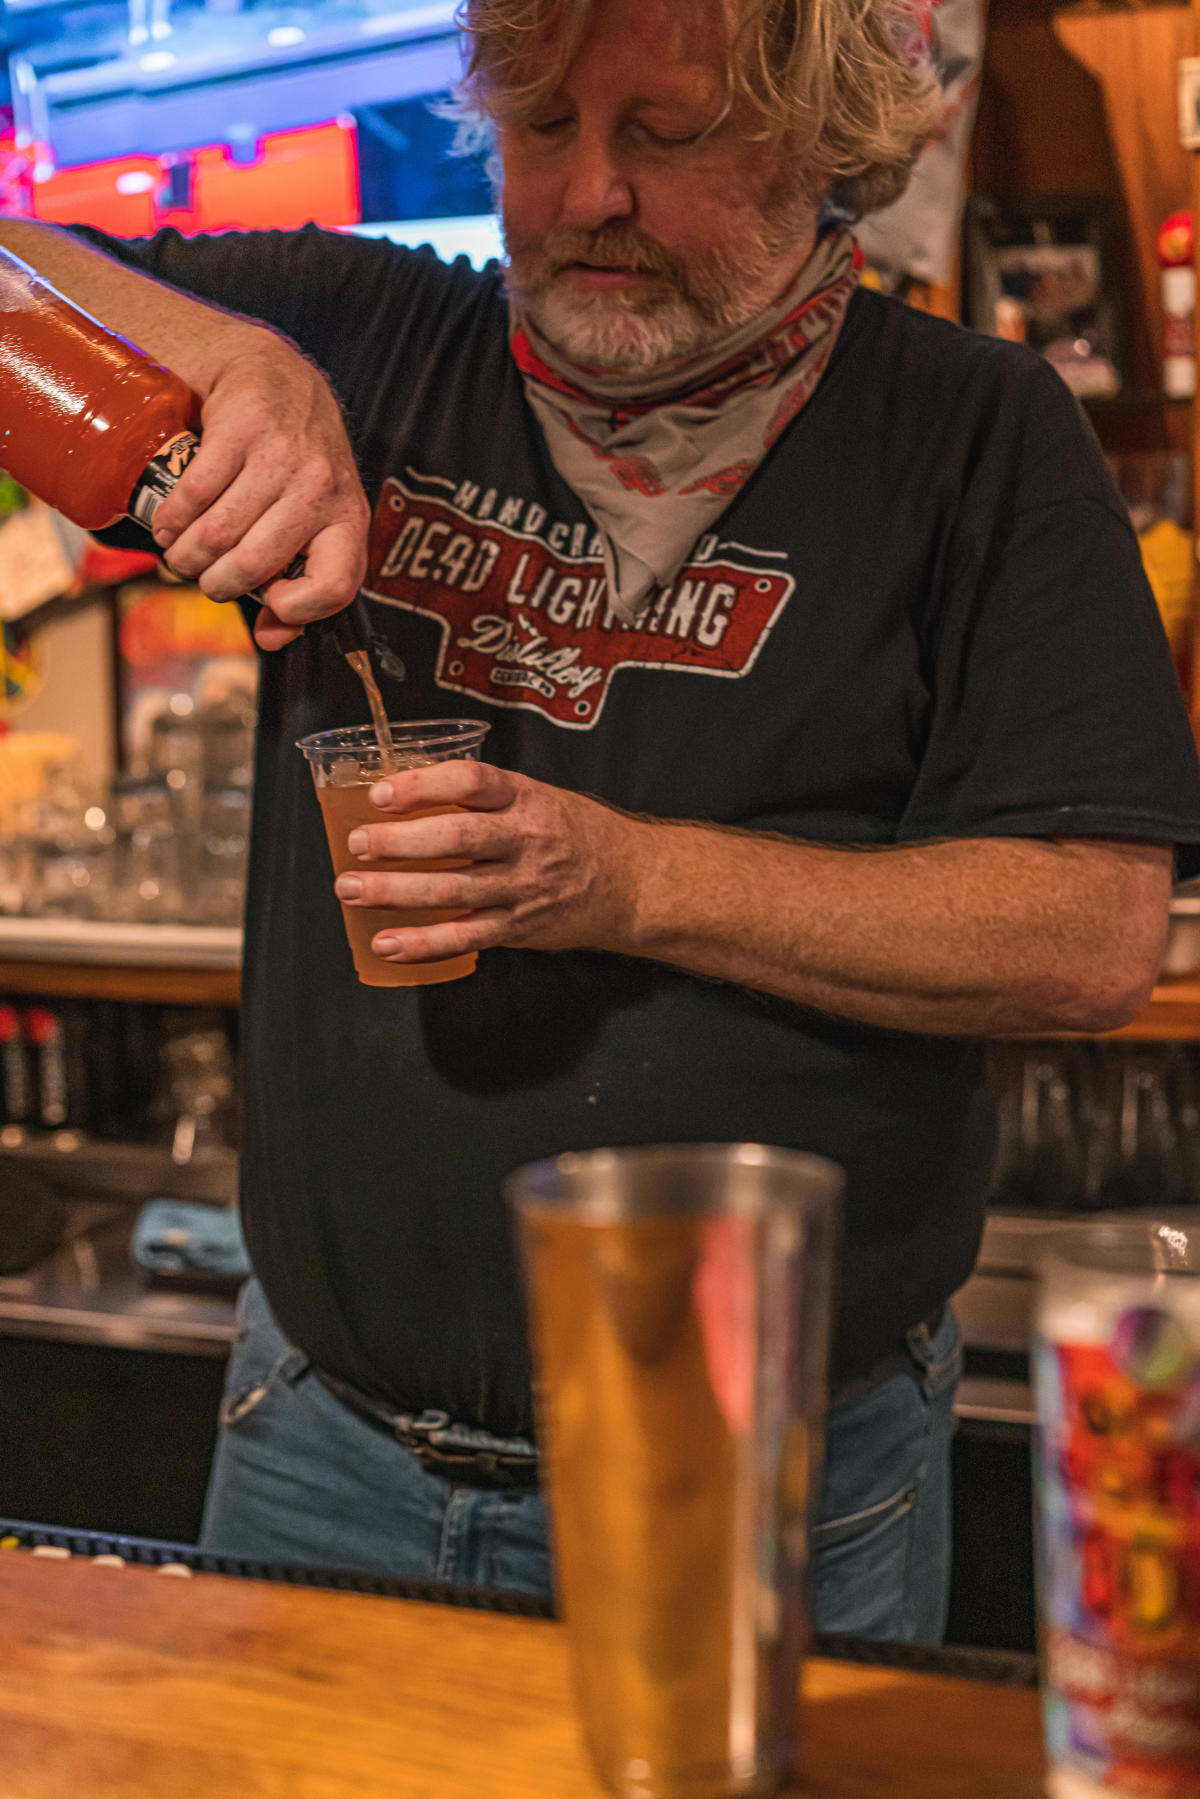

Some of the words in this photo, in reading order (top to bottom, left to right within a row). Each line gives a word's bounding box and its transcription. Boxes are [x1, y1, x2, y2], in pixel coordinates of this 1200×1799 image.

[380, 517, 500, 592] DEAD
[506, 553, 736, 647] LIGHING
[457, 613, 602, 699] Distillery
